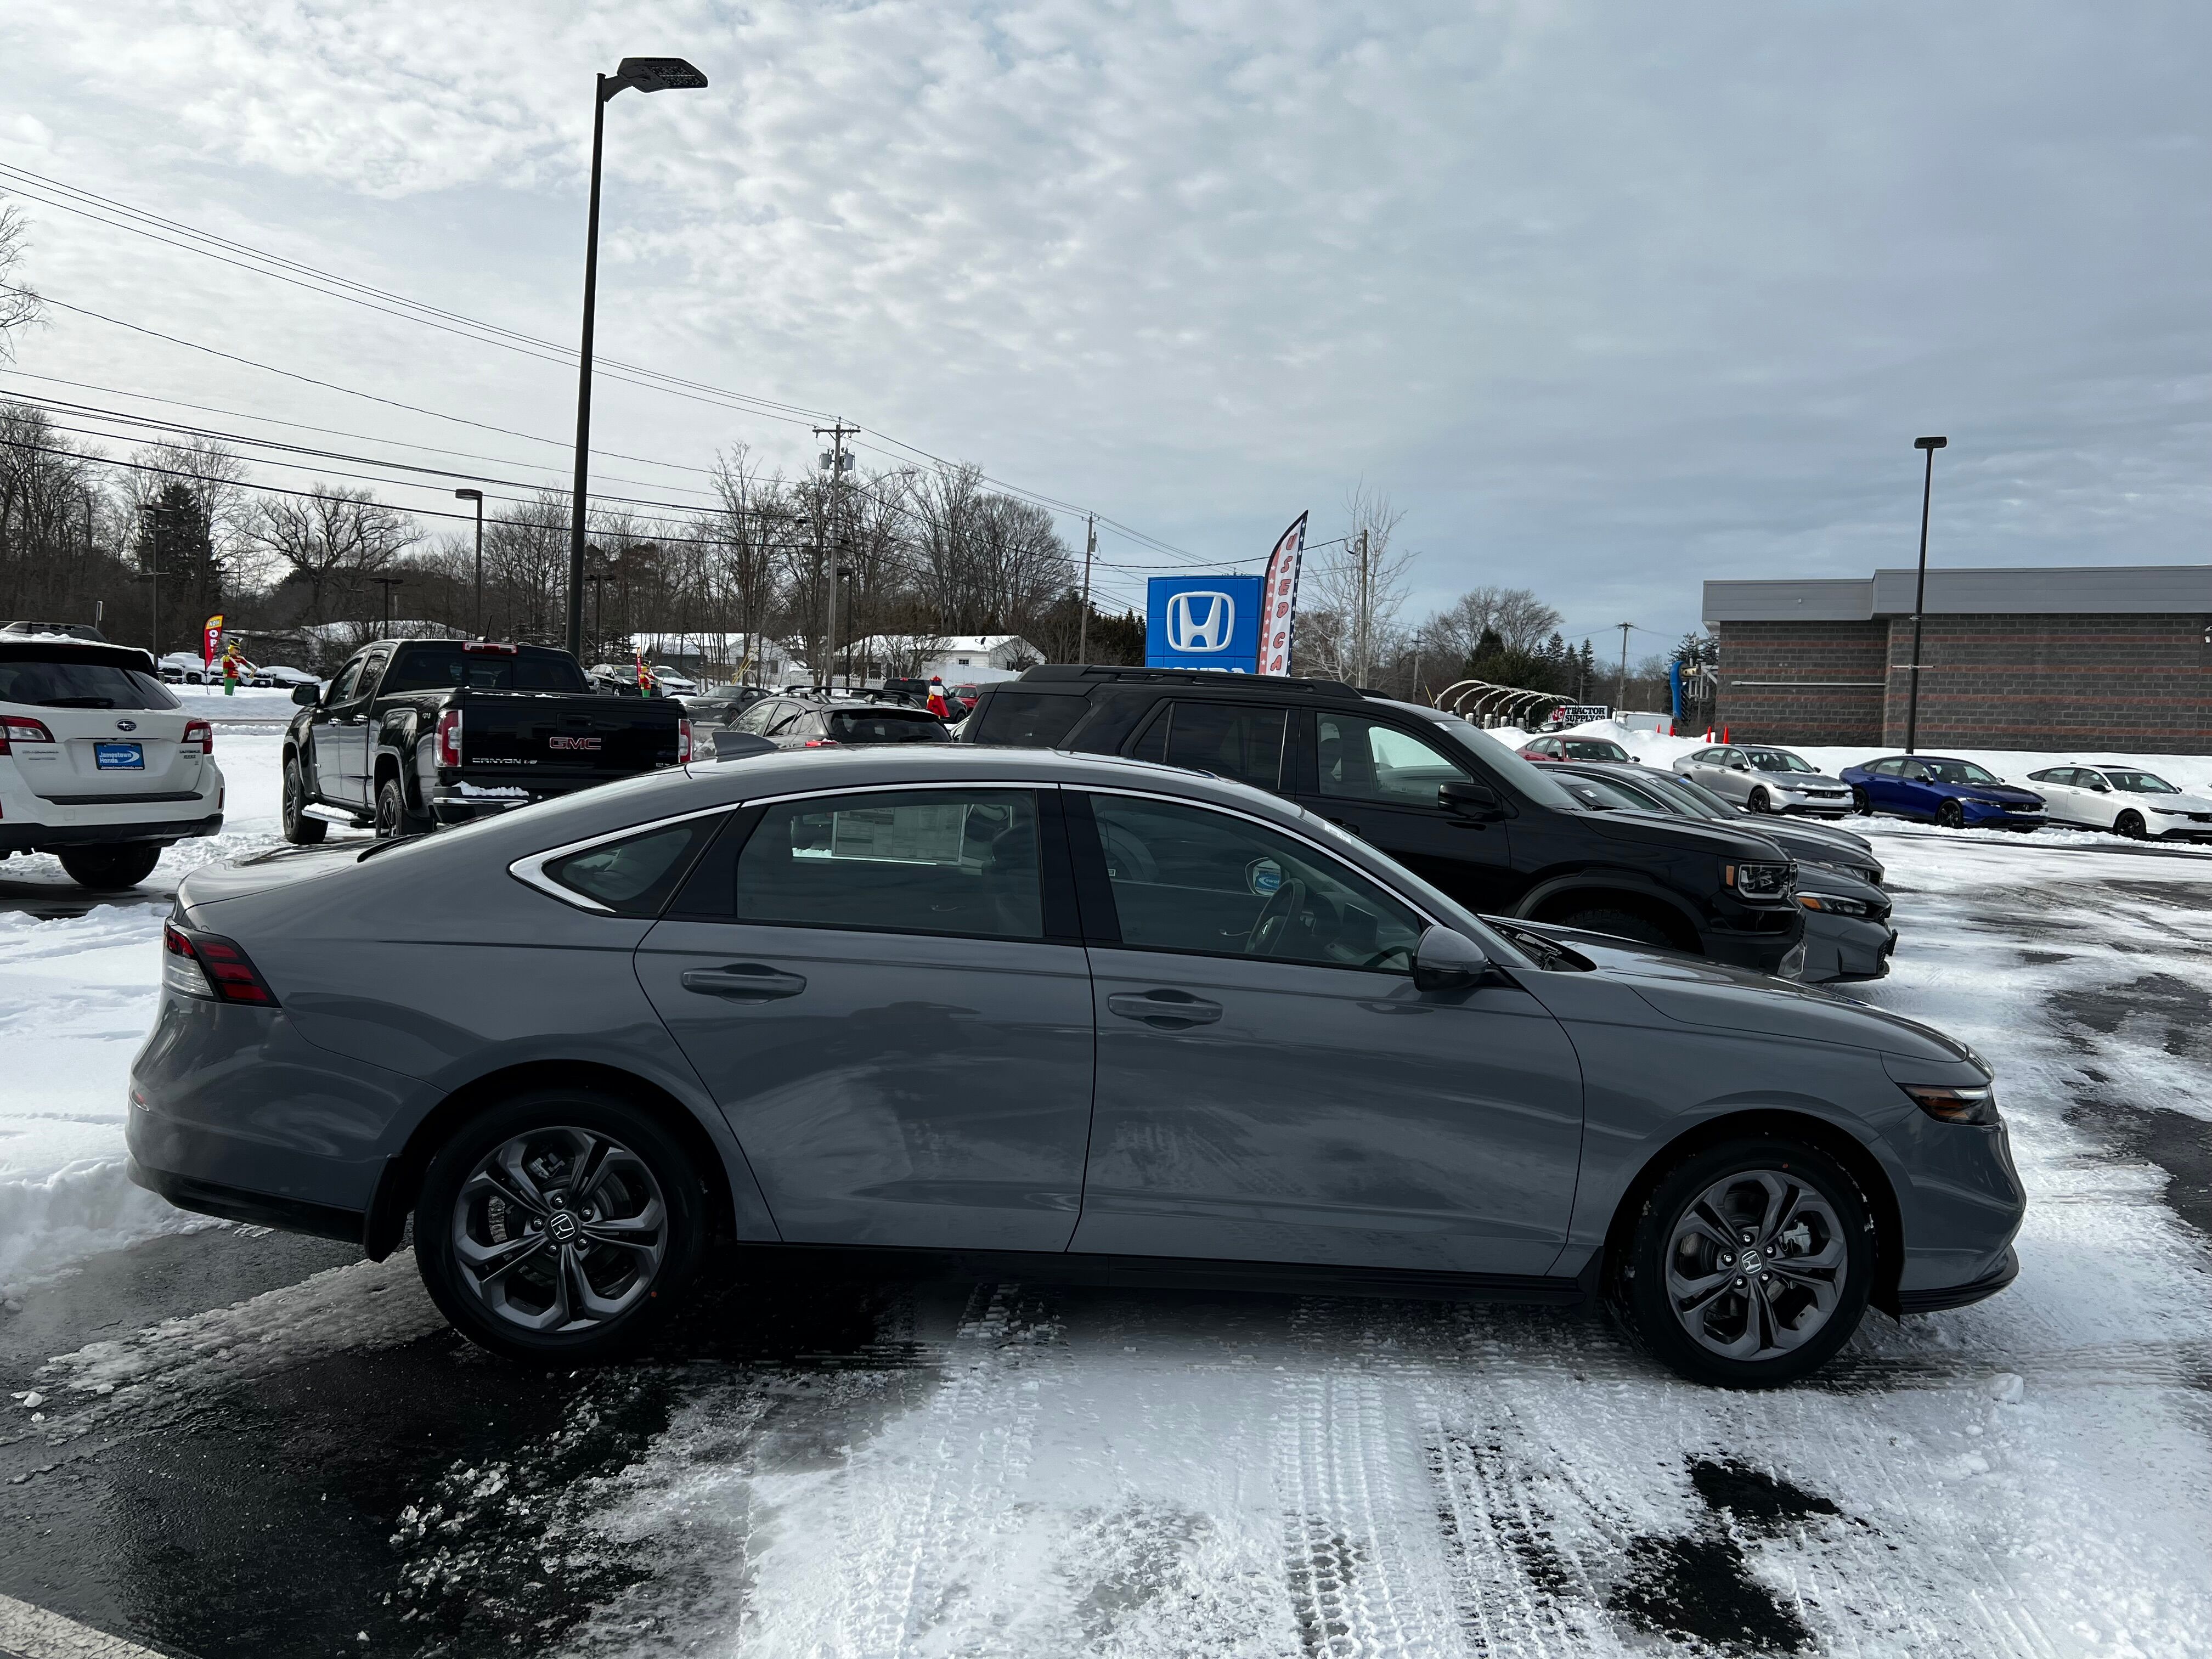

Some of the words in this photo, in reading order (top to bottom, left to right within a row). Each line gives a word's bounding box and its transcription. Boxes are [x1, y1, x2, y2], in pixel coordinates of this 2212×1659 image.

[1276, 533, 1298, 619] USED
[208, 629, 219, 653] OP
[549, 737, 601, 750] GMC
